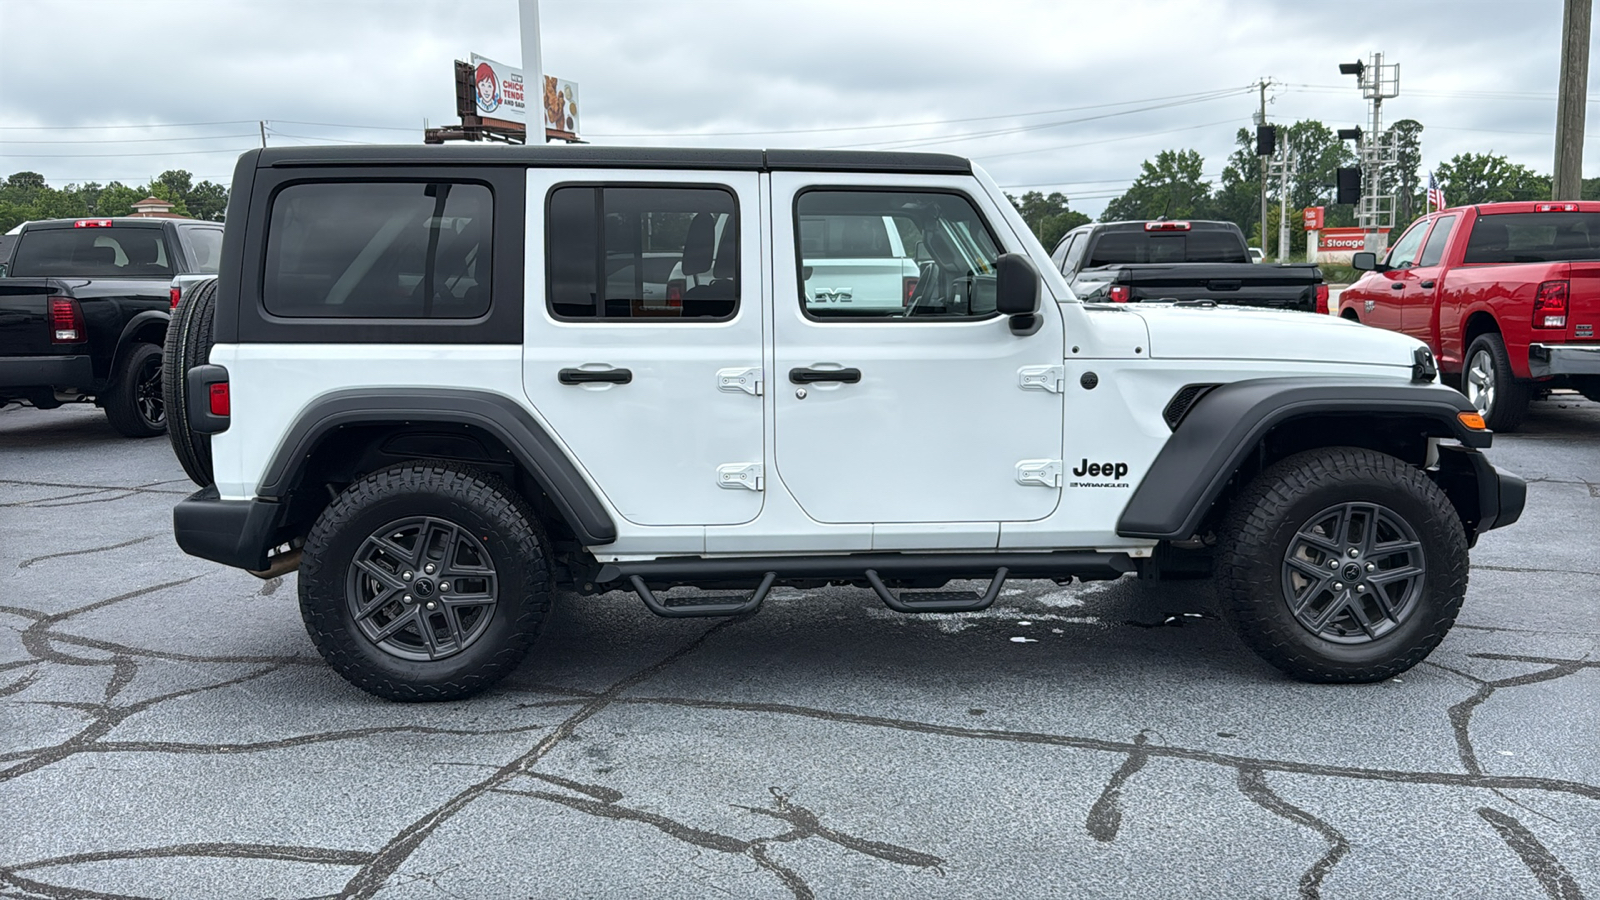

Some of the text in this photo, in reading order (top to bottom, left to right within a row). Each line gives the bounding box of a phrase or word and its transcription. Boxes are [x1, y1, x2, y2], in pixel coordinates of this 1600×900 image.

[503, 89, 524, 101] TENDE
[1327, 239, 1365, 249] Storage
[1072, 458, 1129, 481] Jeep
